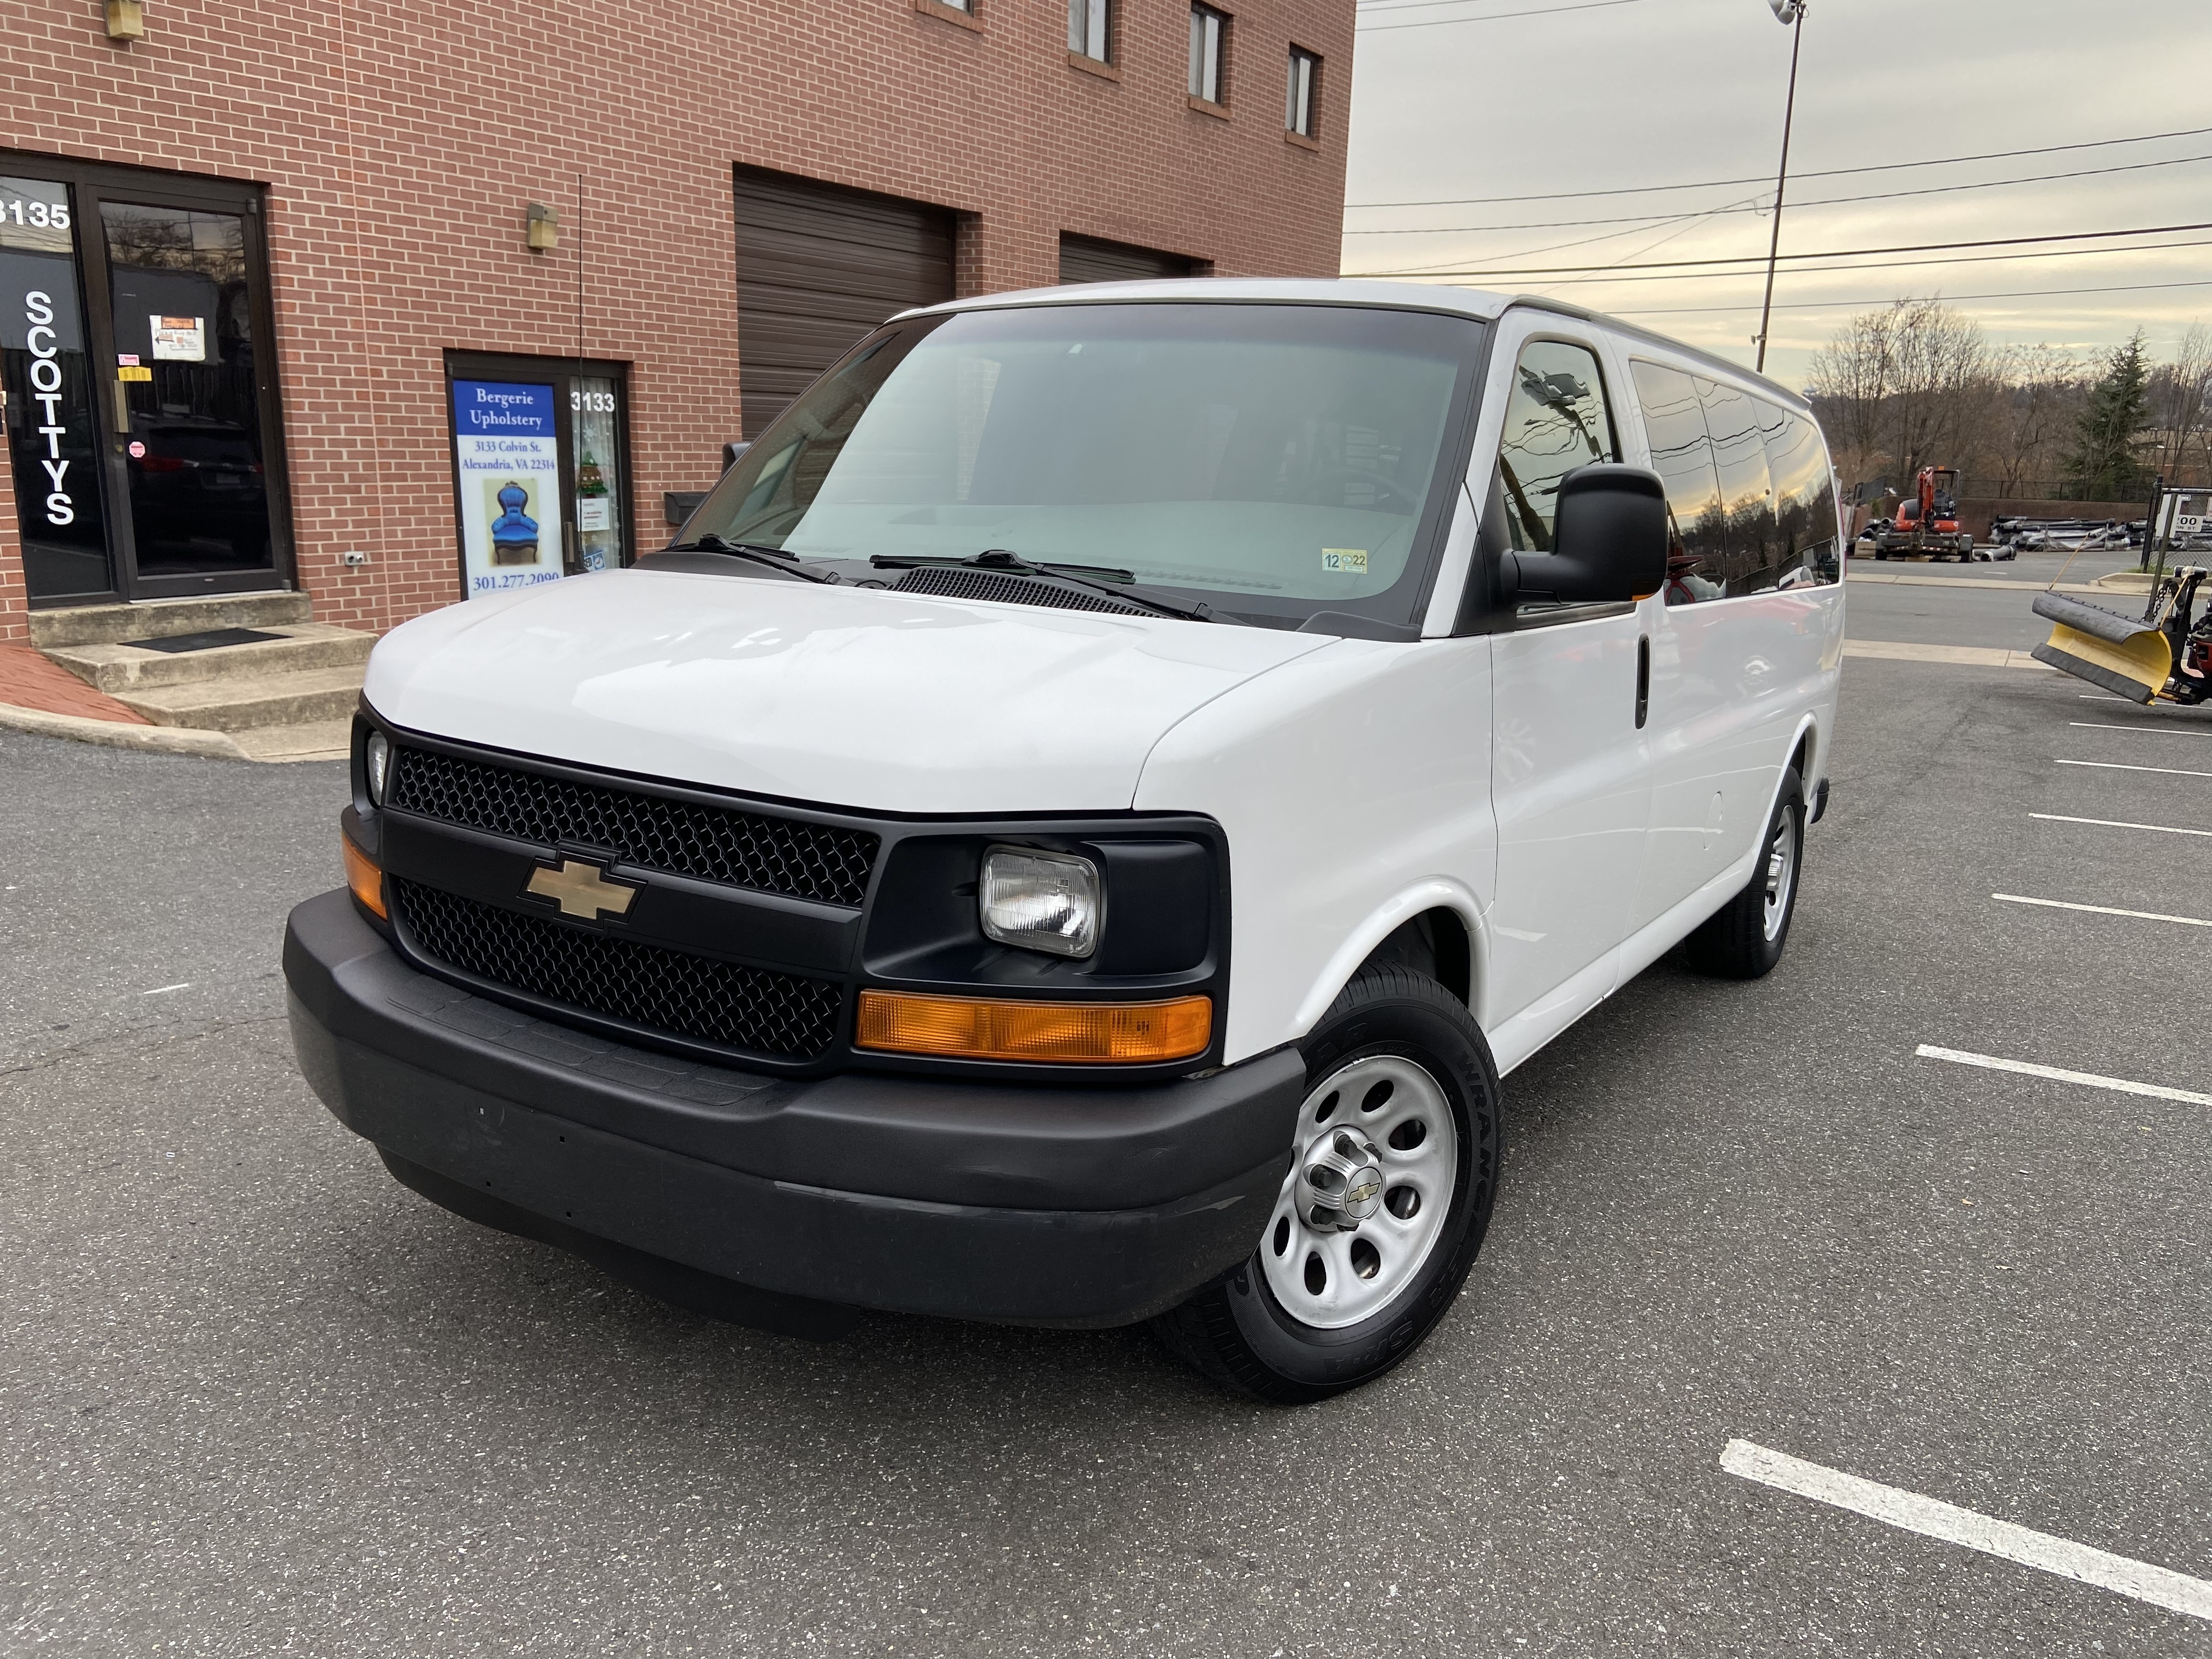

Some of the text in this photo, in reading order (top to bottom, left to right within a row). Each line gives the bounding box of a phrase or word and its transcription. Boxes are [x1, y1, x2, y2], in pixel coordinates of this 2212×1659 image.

[475, 387, 534, 408] Bergerie
[571, 391, 614, 413] 3133
[25, 290, 74, 525] SCOTTYS
[469, 409, 543, 431] Upholstery
[475, 440, 541, 452] 3133 Colvin St.
[462, 458, 555, 471] Alexandria, VA 22314
[2177, 517, 2197, 525] 00
[1325, 554, 1365, 568] 12 22
